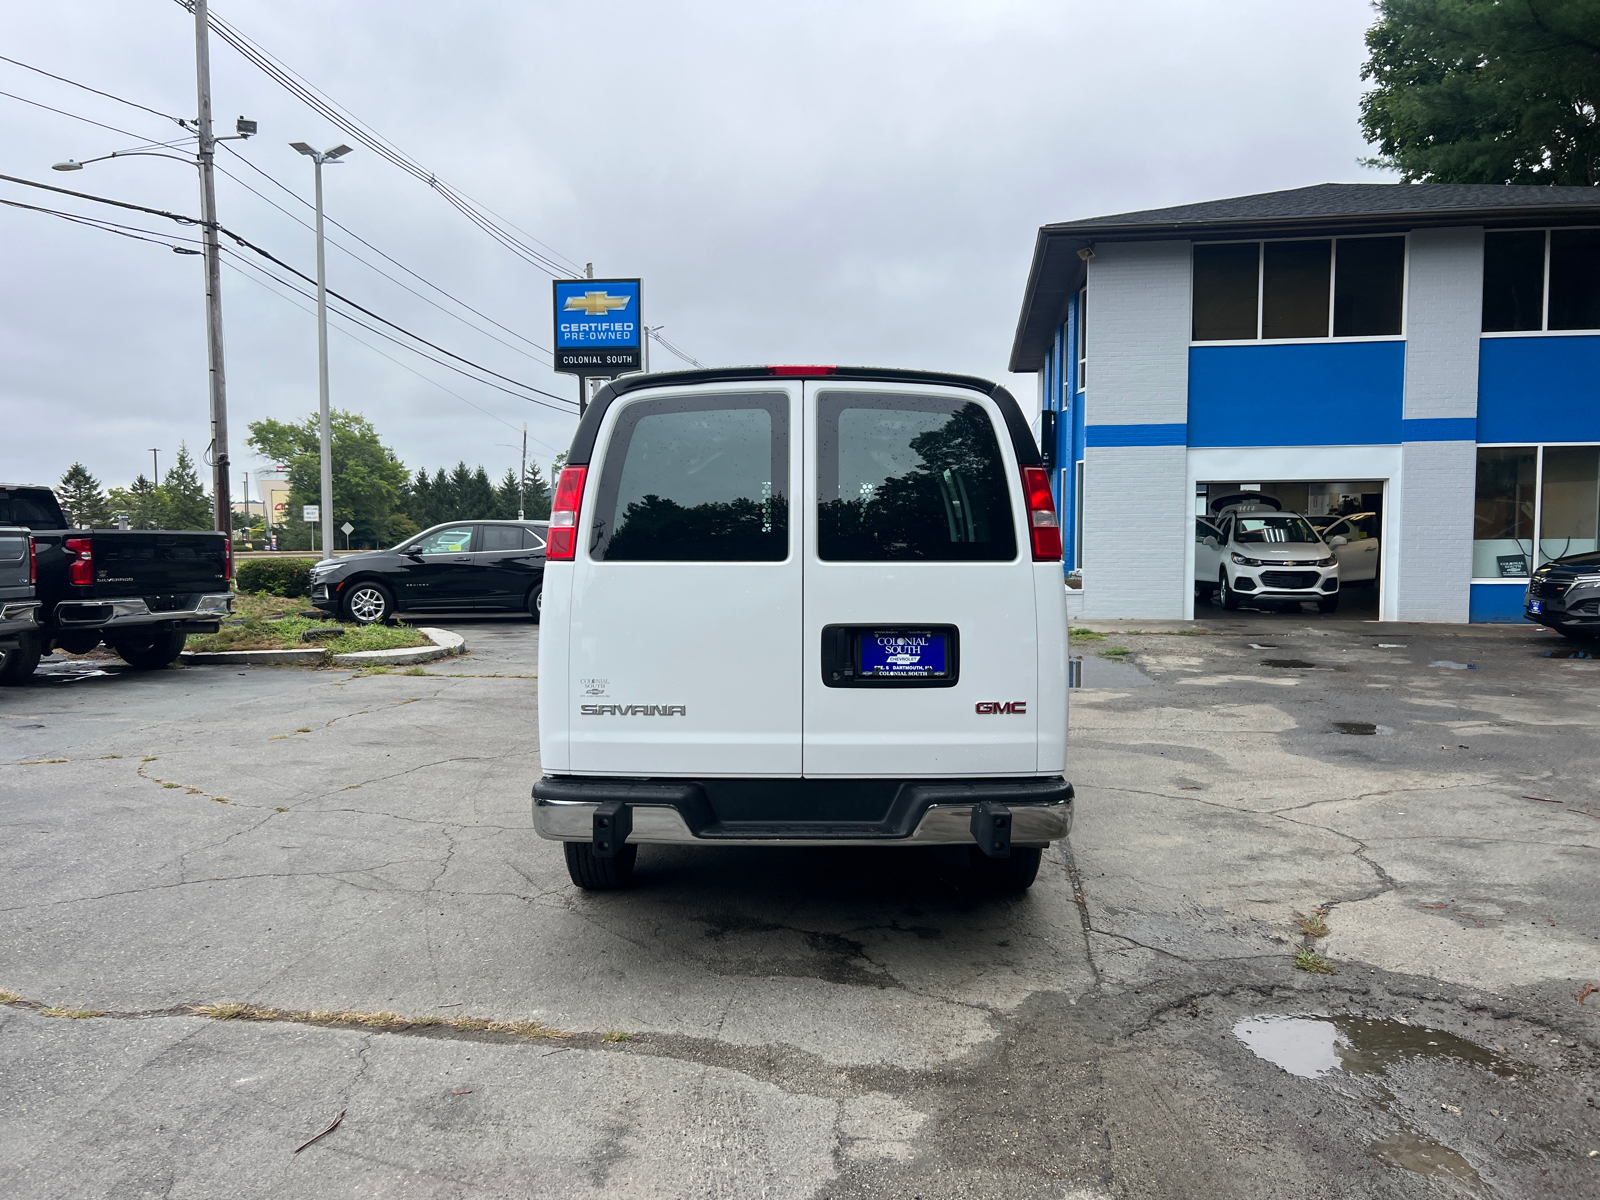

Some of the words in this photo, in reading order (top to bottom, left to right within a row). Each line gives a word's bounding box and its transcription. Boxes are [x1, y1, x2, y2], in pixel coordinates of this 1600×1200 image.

[560, 322, 634, 332] CERTIFIED
[564, 332, 630, 340] PRE-OWNED
[606, 356, 632, 364] SOUTH
[878, 638, 928, 646] COLONIAL
[580, 704, 686, 716] SAVANA
[975, 701, 1026, 714] GMC
